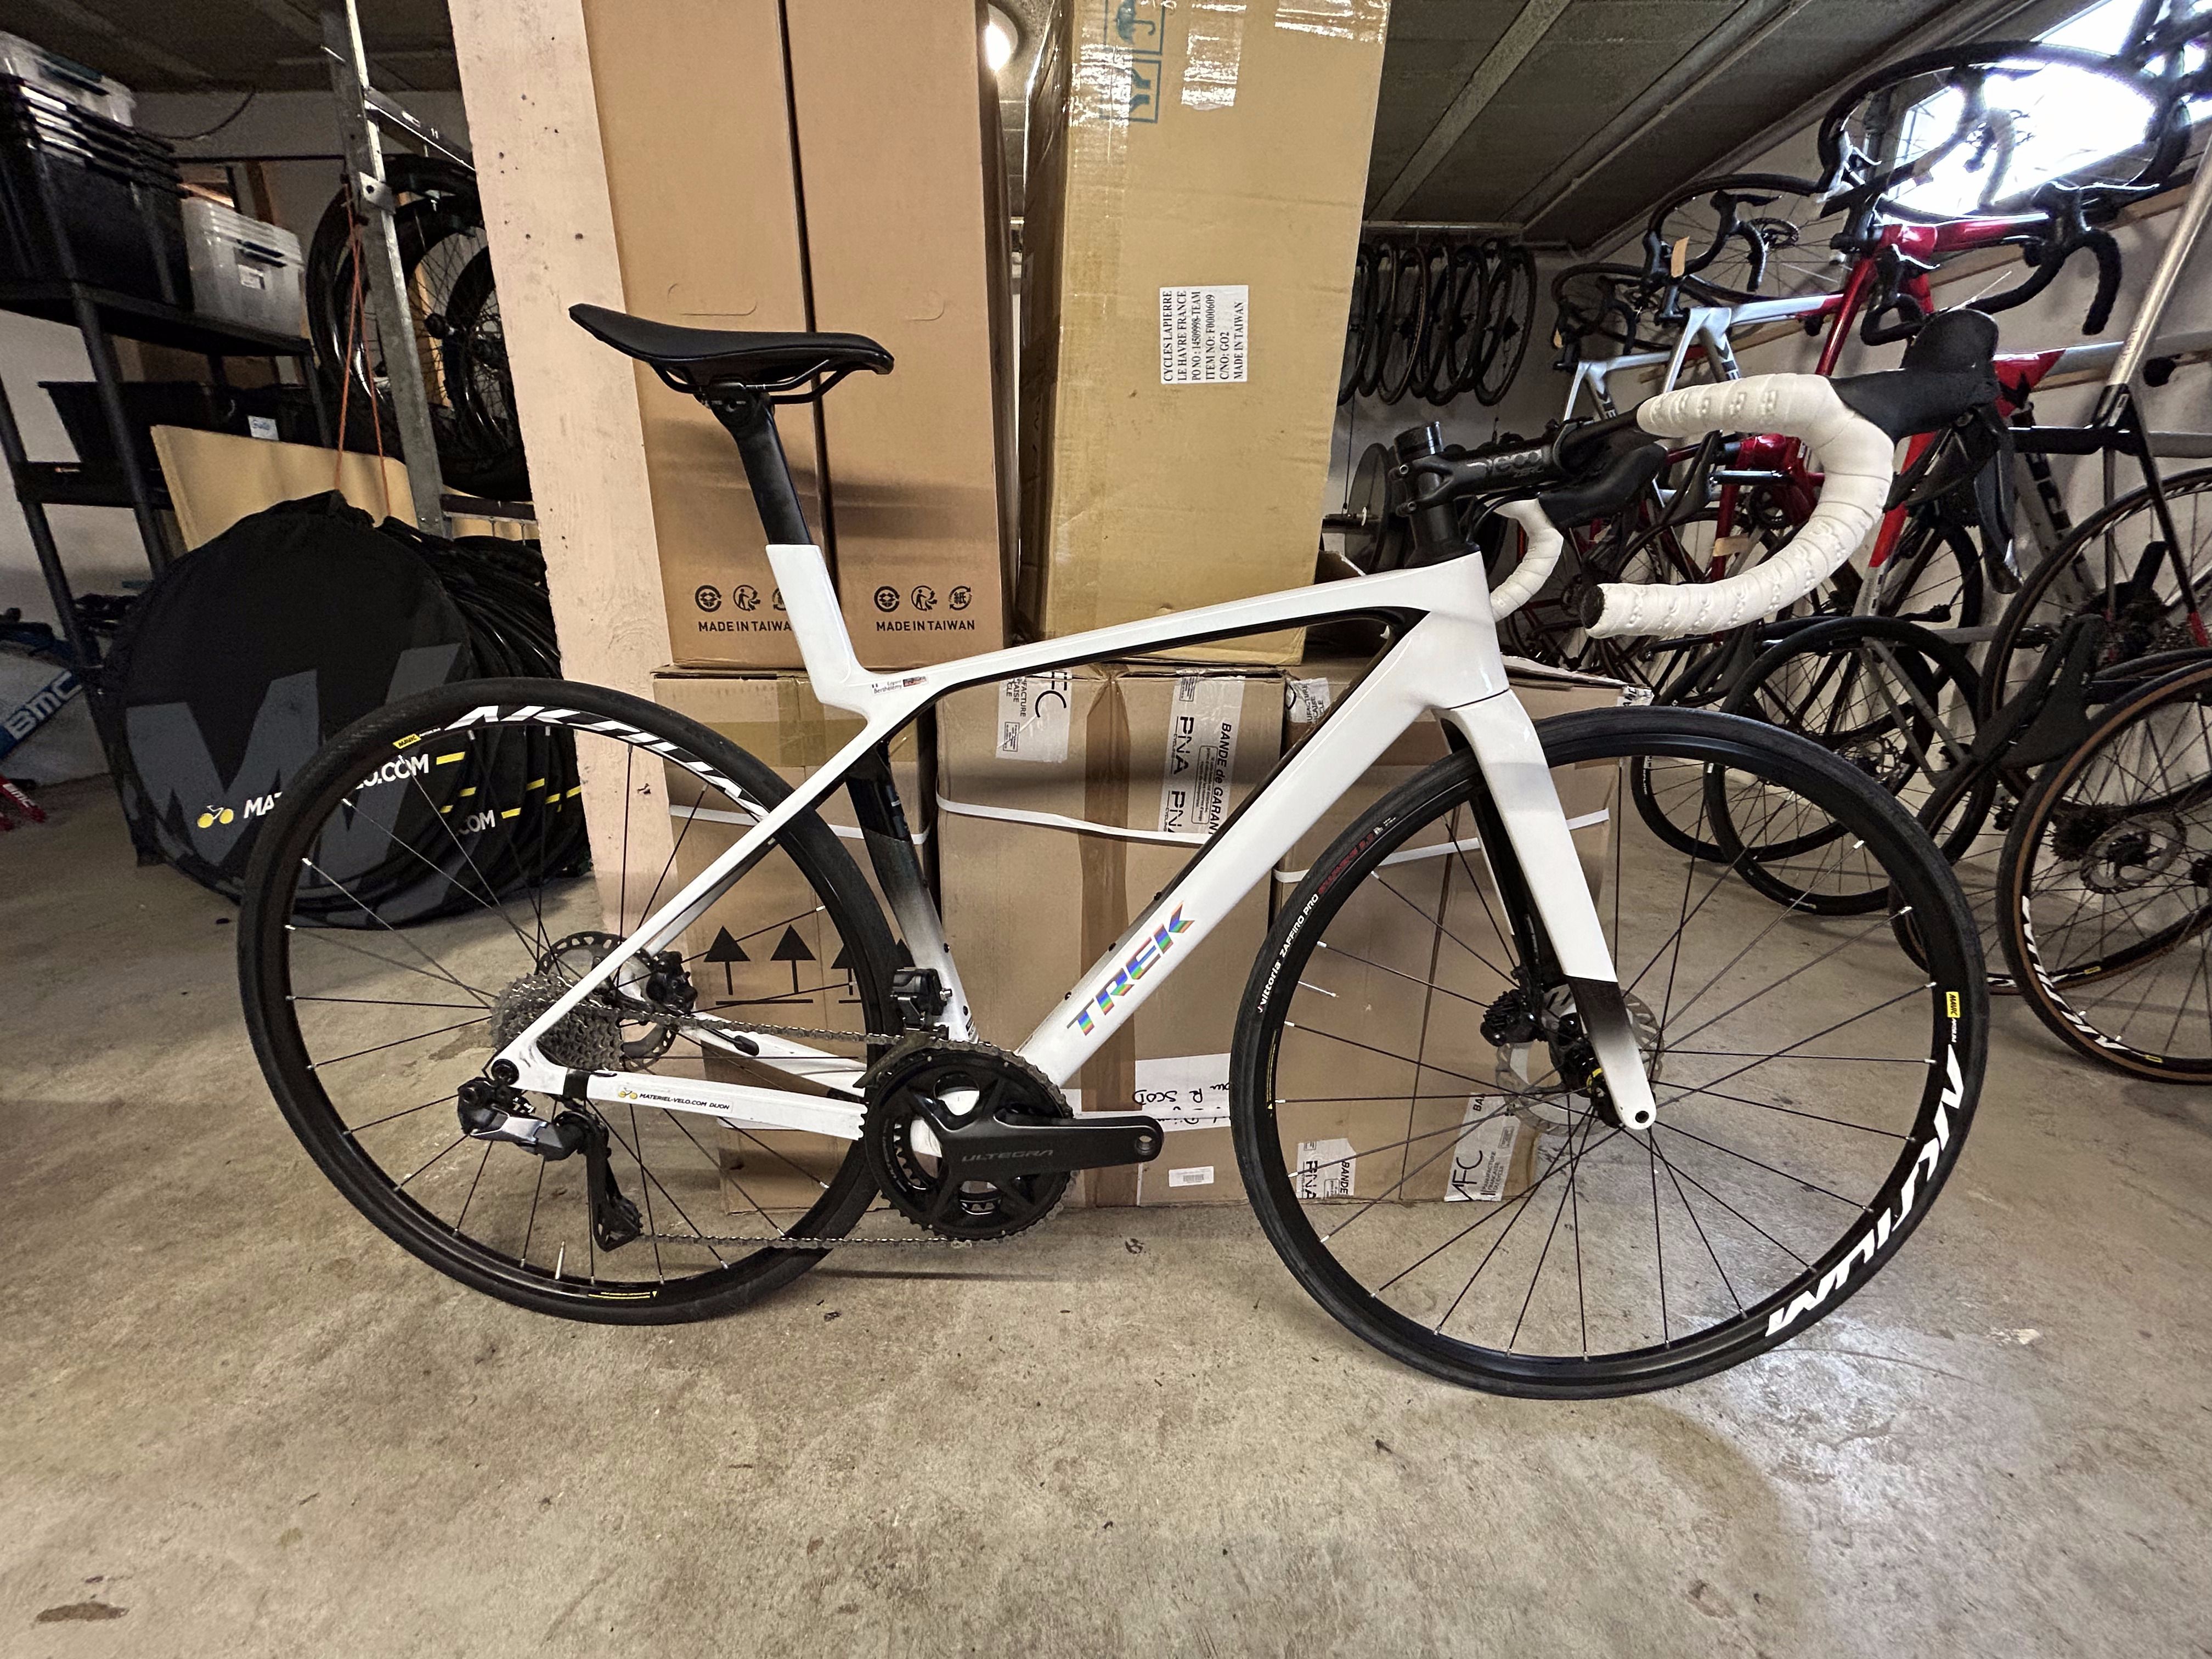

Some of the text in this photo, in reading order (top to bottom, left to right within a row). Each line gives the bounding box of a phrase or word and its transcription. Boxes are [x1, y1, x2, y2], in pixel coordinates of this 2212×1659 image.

[1163, 291, 1173, 381] CYCLES LAPIERRE
[1177, 290, 1187, 381] LE HAVRE FRANCE
[1206, 336, 1215, 353] NO:
[1234, 302, 1244, 379] MADE IN TAIWAN
[1192, 370, 1201, 380] PO
[1206, 356, 1215, 380] ITEM
[1220, 354, 1229, 380] C/NO:
[698, 621, 793, 631] MADE IN TAIWA
[876, 620, 975, 631] MADE IN TAIWAN
[3, 670, 83, 740] BMC
[1217, 723, 1232, 767] BANDE
[1215, 769, 1225, 783] de
[1279, 915, 1305, 958] ZAFFIRO
[1303, 893, 1319, 916] PRO
[1066, 900, 1195, 1036] TREK
[639, 1093, 707, 1107] MATERIEL-VELO.COM
[962, 1150, 1053, 1162] ULTEGRA
[1340, 1160, 1350, 1194] BANDE
